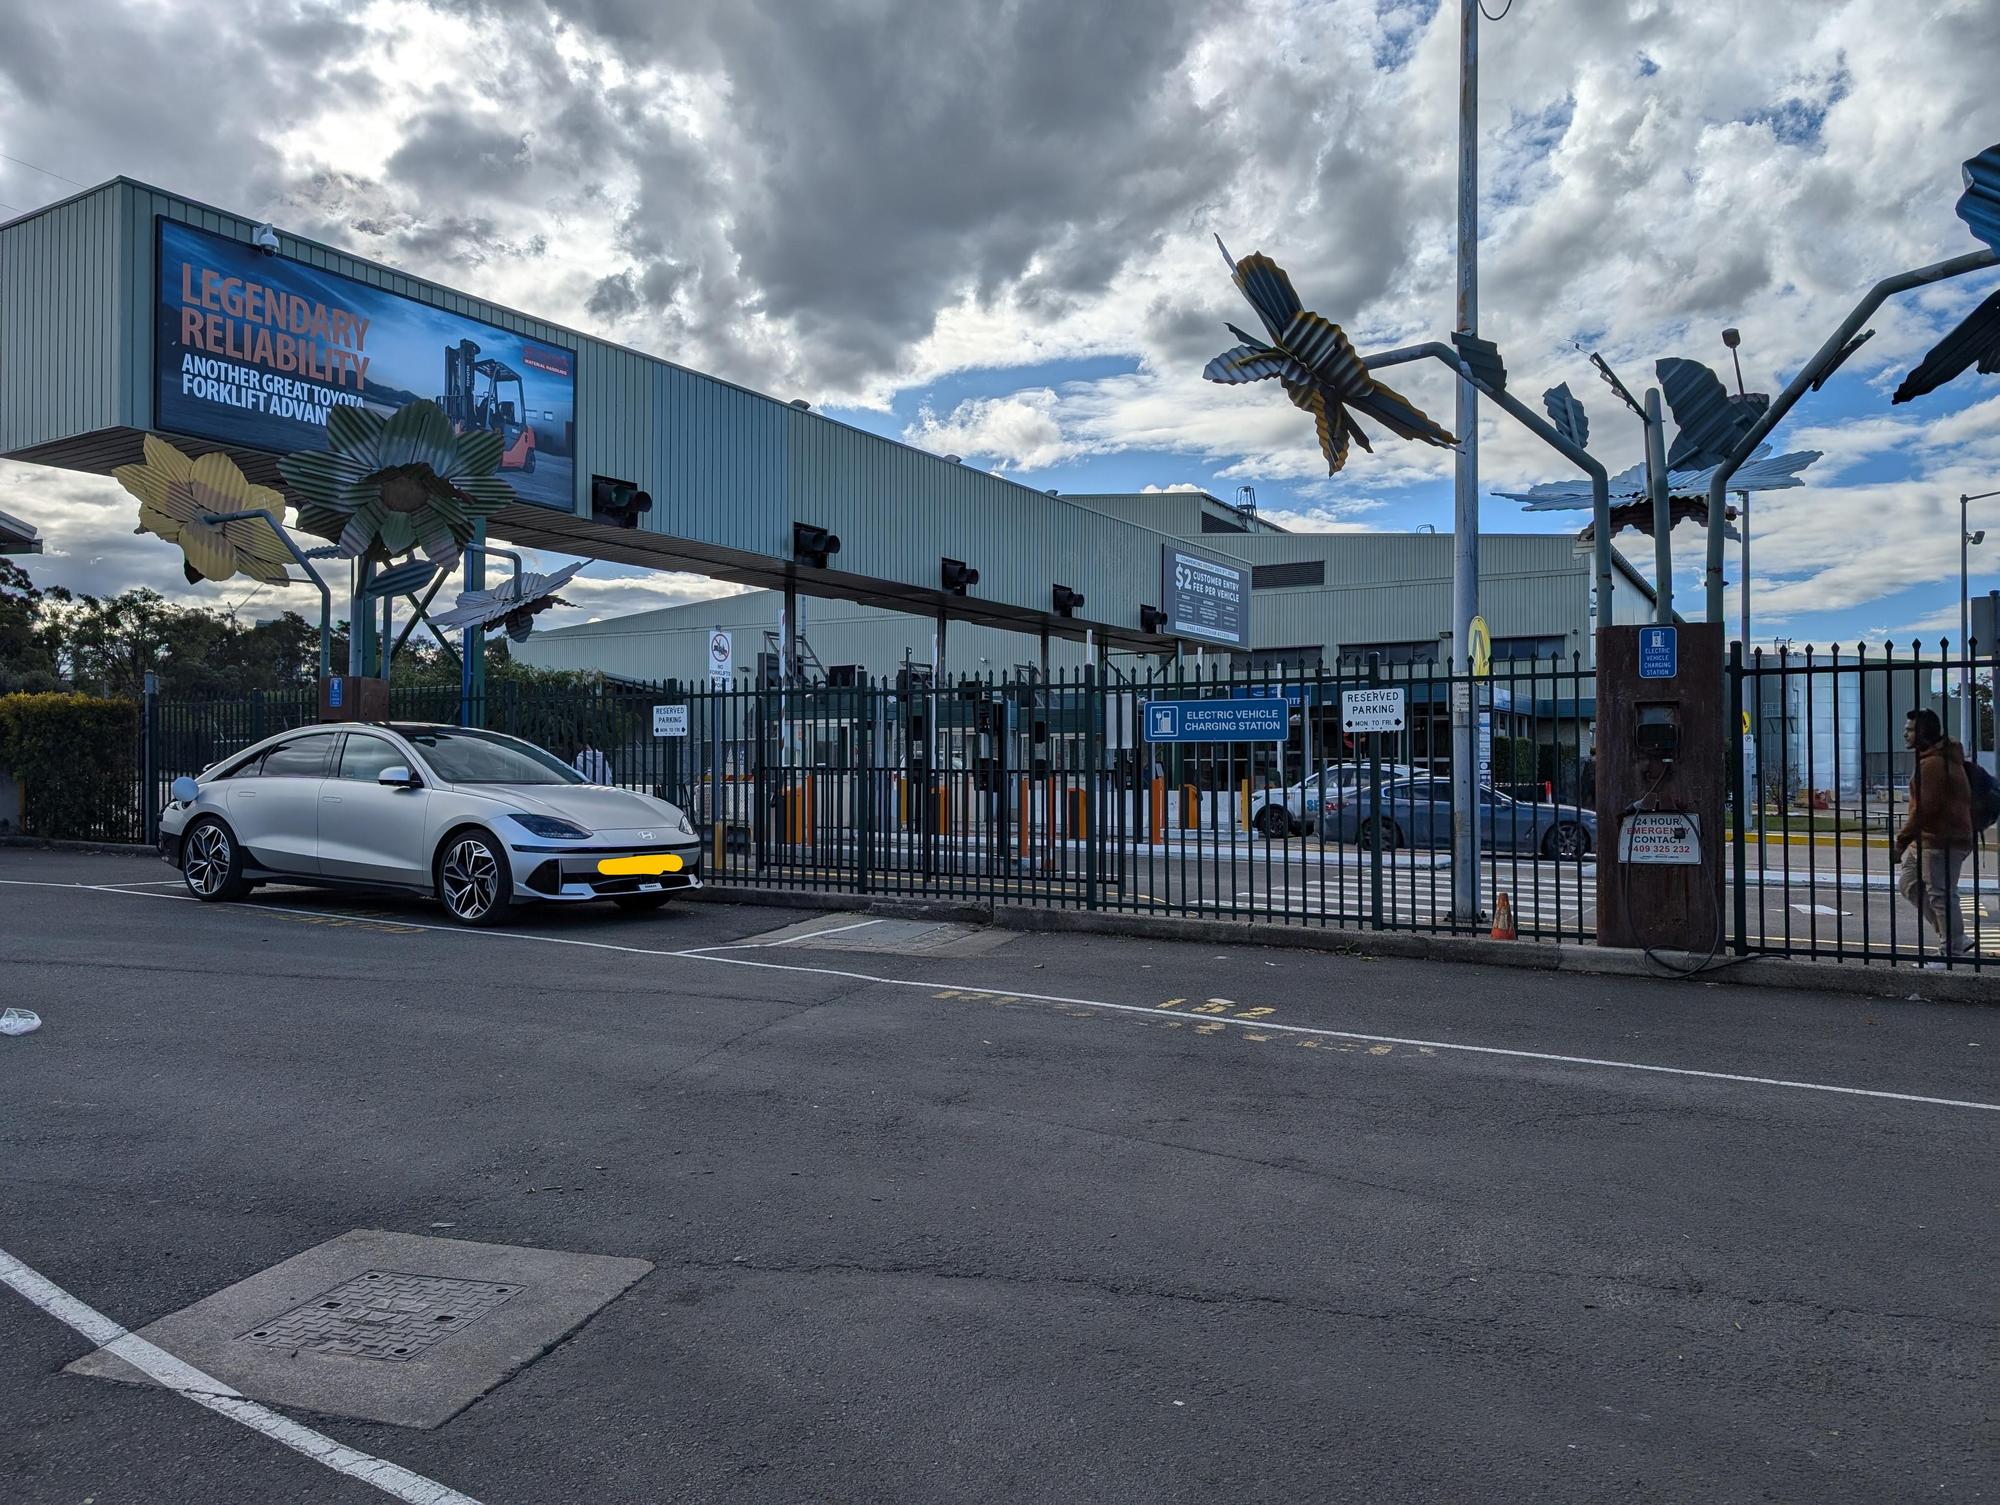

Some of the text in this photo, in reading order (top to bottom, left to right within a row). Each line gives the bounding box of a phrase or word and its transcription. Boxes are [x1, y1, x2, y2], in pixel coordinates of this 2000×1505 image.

[182, 263, 370, 352] LEGENDARY
[181, 306, 370, 391] RELIABILITY
[181, 353, 260, 389] ANOTHER
[262, 374, 310, 400] GREAT
[182, 374, 332, 426] FORKLIFT ADVAN
[1175, 563, 1192, 590] $2
[1193, 571, 1239, 592] CUSTOMER ENTRY
[1193, 582, 1204, 593] FEE
[1205, 585, 1216, 597] PER
[1217, 589, 1239, 603] VEHICLE
[1347, 691, 1399, 703] RESERVED
[1186, 709, 1279, 720] ELECTRIC VEHICLE
[1352, 704, 1395, 715] PARKING
[658, 716, 682, 724] PARKING
[1185, 721, 1280, 731] CHARGING STATION
[1636, 818, 1680, 826] 24 HOUR
[1627, 826, 1691, 835] EMERGENY
[1653, 845, 1671, 853] 325
[1672, 845, 1690, 853] 232
